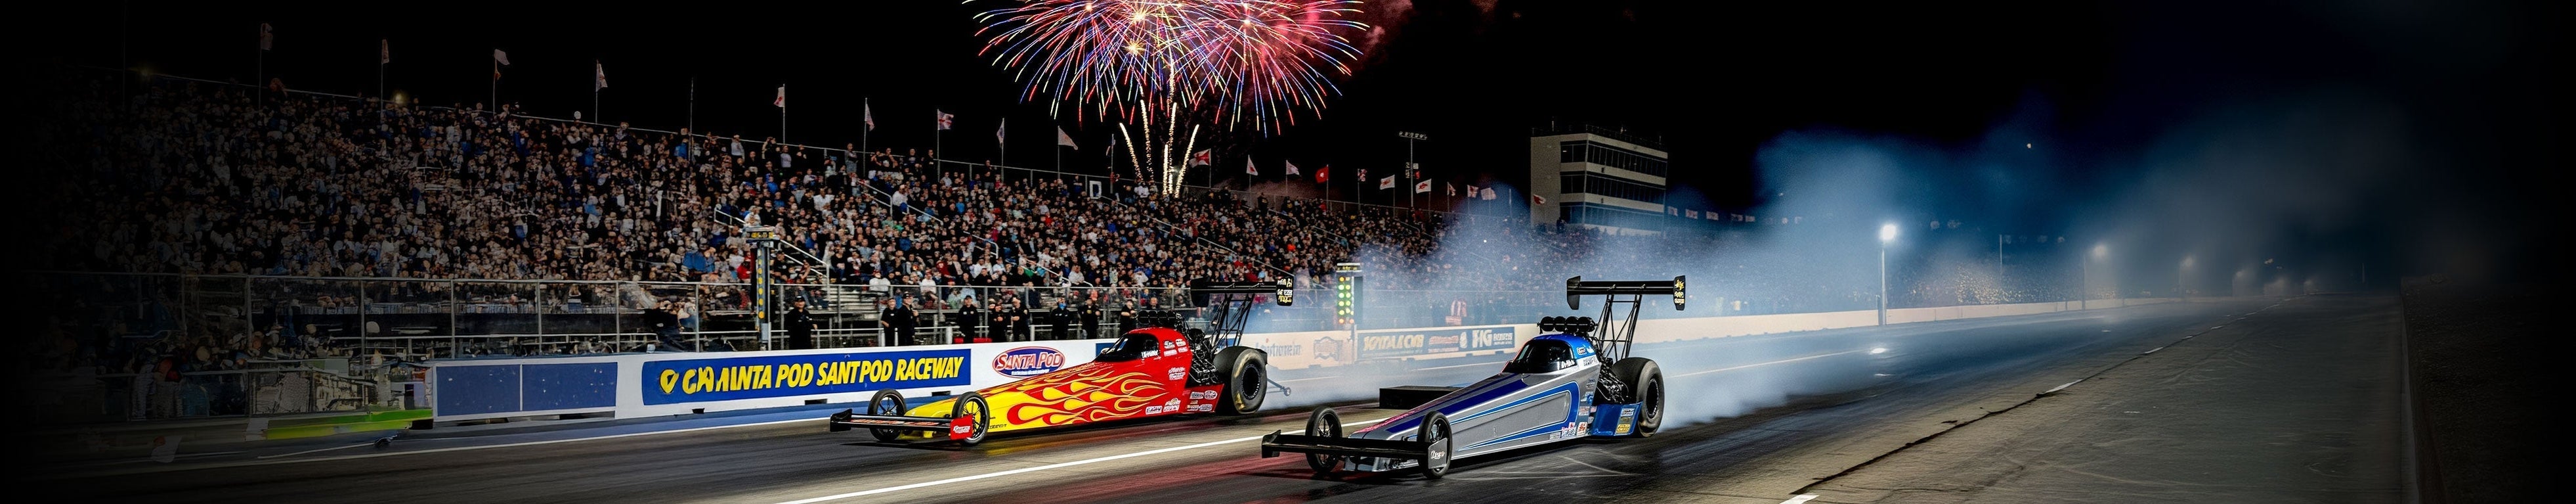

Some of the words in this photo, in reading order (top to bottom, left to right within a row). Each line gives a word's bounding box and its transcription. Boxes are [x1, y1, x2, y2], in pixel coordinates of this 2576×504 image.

[775, 363, 814, 388] POD
[895, 356, 964, 381] RACEWAY
[996, 353, 1036, 370] SANTA
[1037, 352, 1062, 368] POD
